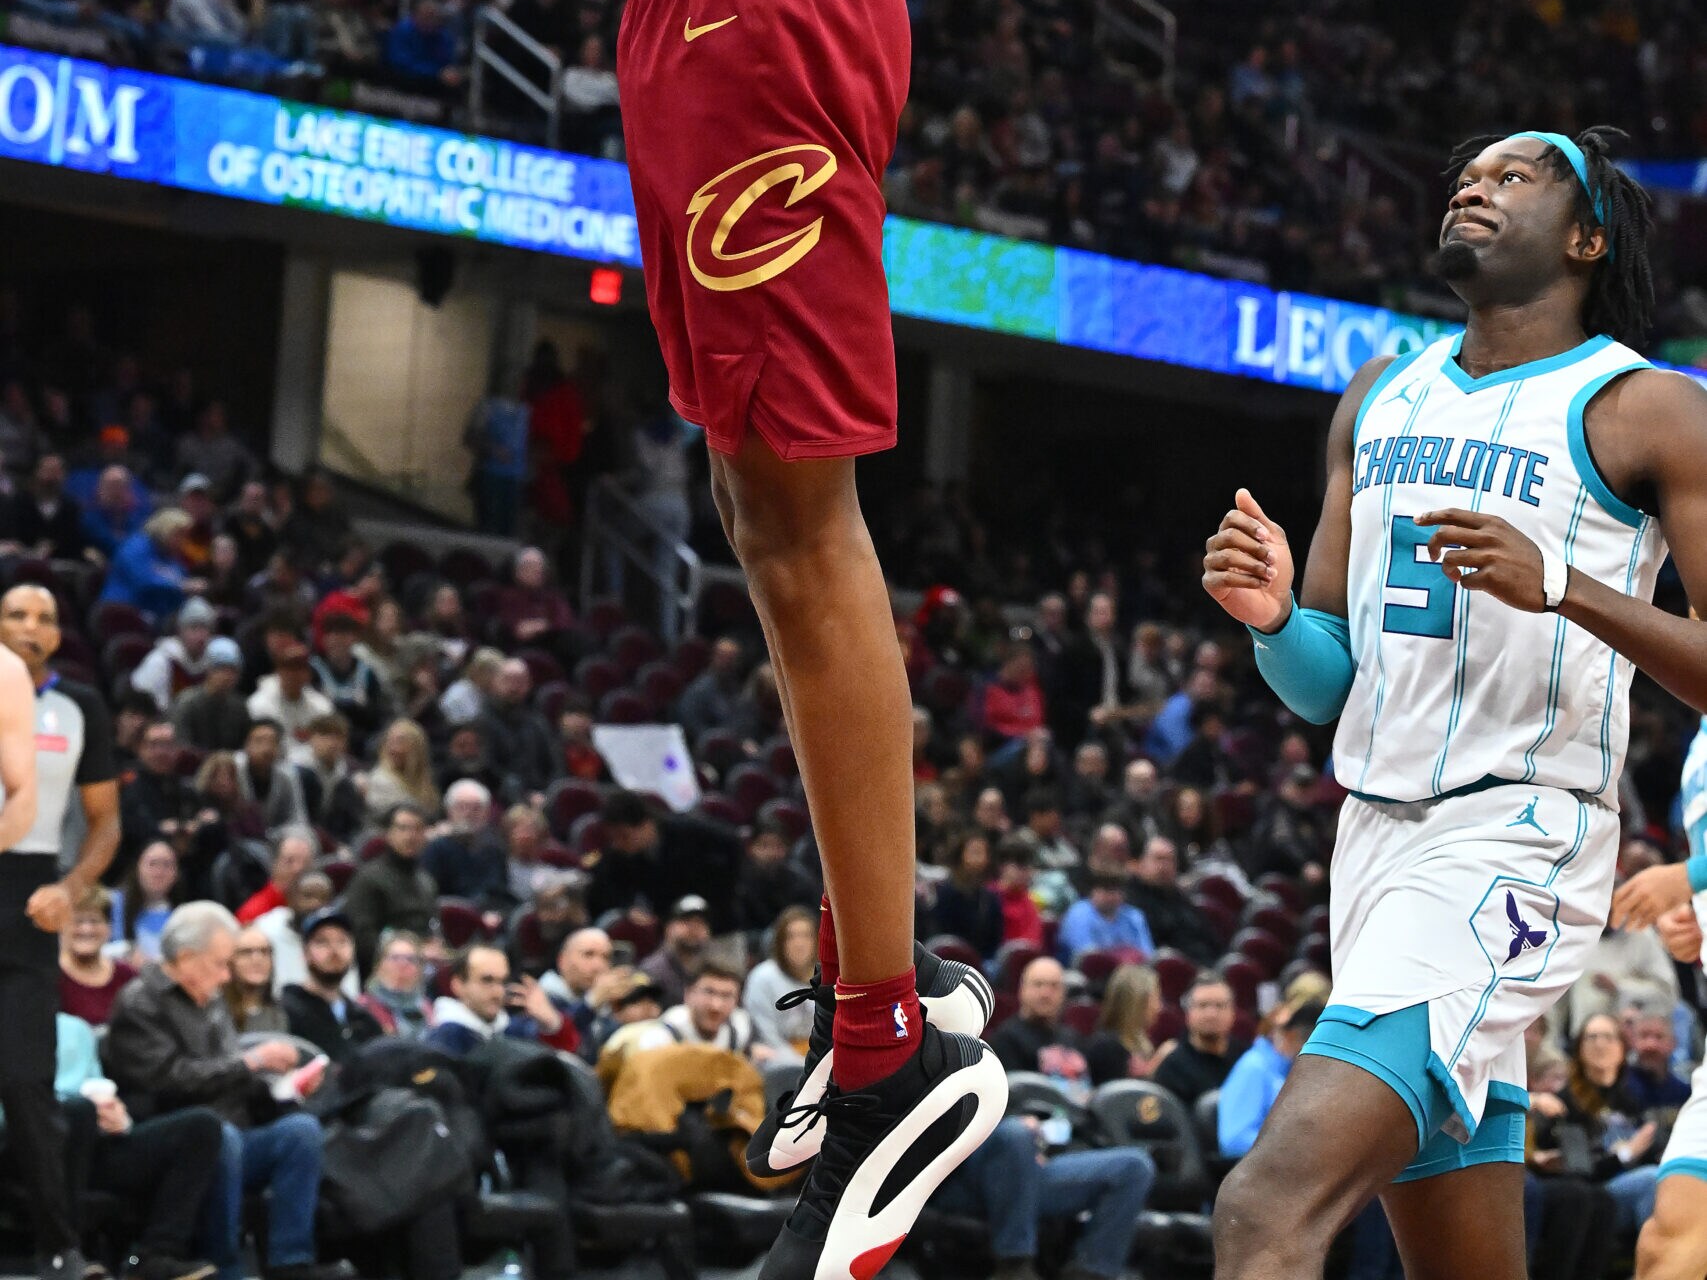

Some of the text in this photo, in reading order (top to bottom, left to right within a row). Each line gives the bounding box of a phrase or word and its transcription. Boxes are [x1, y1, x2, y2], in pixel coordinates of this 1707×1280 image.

[208, 141, 636, 257] OF OSTEOPATHIC MEDICINE
[274, 107, 576, 202] LAKE ERIE COLLEGE
[1352, 435, 1549, 507] CHARLOTTE
[1382, 514, 1461, 640] 5
